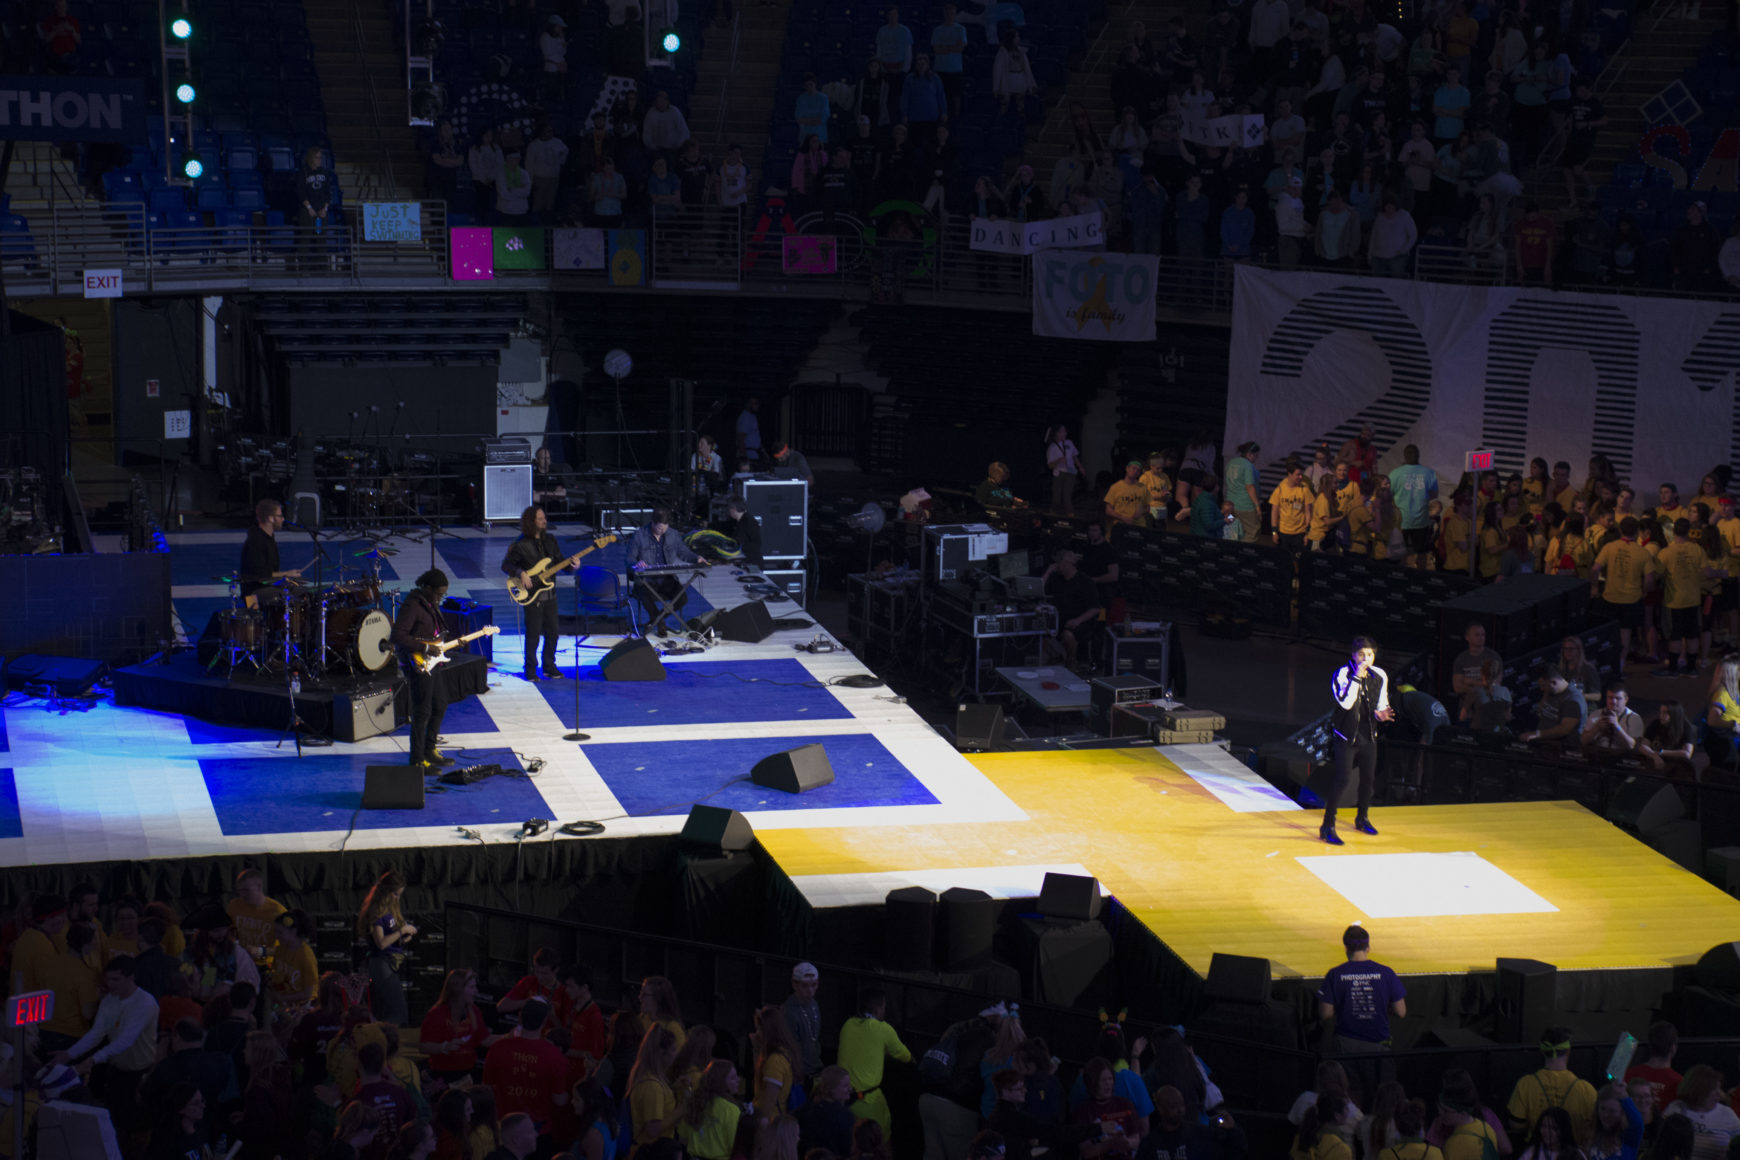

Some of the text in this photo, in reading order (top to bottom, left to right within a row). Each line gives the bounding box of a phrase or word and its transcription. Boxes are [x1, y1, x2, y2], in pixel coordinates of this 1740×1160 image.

[369, 204, 410, 219] JUST
[372, 220, 402, 231] KEEP
[975, 223, 1098, 247] DANCING
[86, 275, 121, 289] EXIT
[1045, 260, 1149, 305] FOTO
[1080, 308, 1126, 328] family
[1472, 452, 1492, 469] EXIT
[1340, 973, 1382, 982] PHOTOGRAPHY
[15, 993, 50, 1026] EXIT
